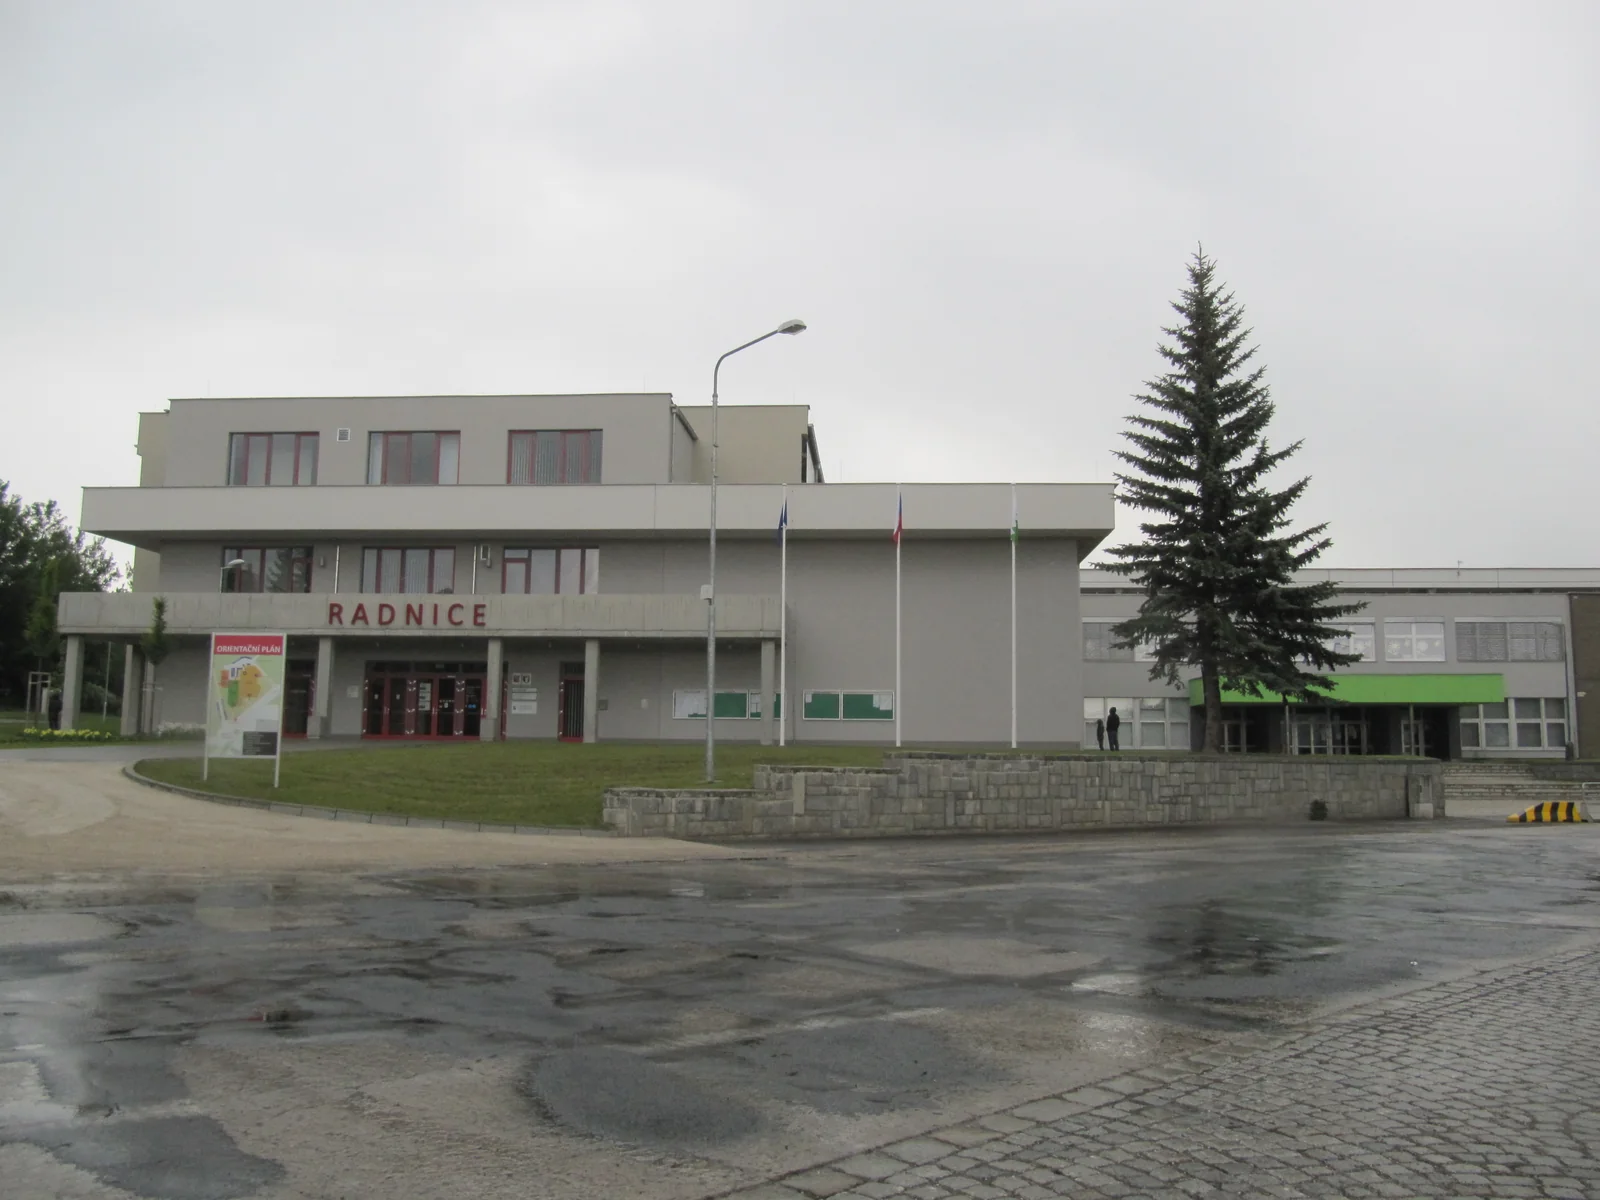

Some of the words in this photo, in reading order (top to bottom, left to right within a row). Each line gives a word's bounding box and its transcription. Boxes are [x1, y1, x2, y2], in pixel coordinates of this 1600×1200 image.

[328, 603, 487, 626] RADNICE
[216, 644, 260, 653] ORIENTAČNÍ
[261, 644, 281, 653] PLÁN
